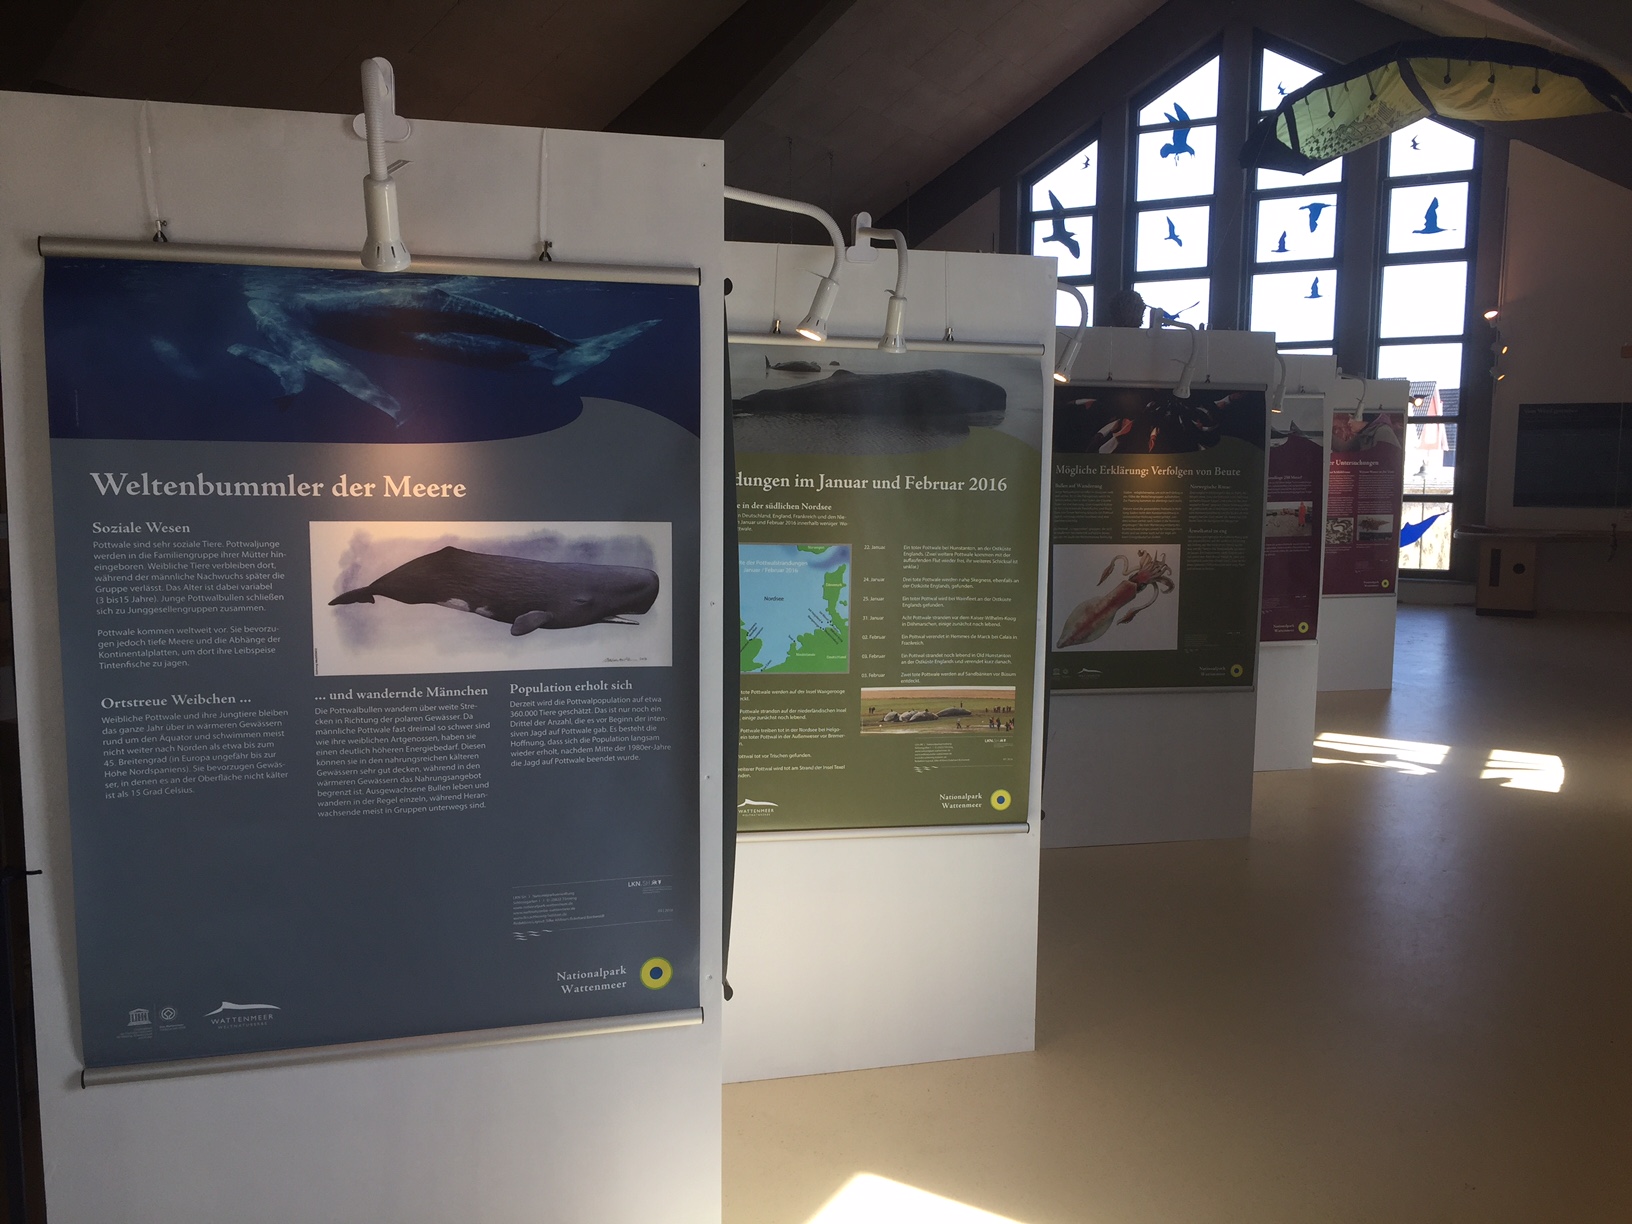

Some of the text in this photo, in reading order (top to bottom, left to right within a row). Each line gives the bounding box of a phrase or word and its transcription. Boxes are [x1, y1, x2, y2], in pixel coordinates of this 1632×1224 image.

[1055, 465, 1098, 477] Mögliche
[1099, 465, 1149, 477] Erklärung:
[1150, 466, 1194, 478] Verfolgen
[1213, 466, 1241, 476] Beute
[91, 472, 466, 498] Weltenbummler der Meere
[735, 472, 1008, 493] dungen im Januar und Februar 2016
[741, 501, 832, 510] in der südlichen Nordsee
[92, 522, 191, 533] Soziale Wesen
[93, 539, 280, 550] Pottwale sind sehr soziale Tiere. Pottwaljunge
[93, 550, 287, 561] werden in die Familiengruppe ihrer Mütter hin-
[147, 561, 188, 570] Weibliche
[189, 561, 210, 570] Tiere
[211, 561, 255, 569] verbleiben
[159, 594, 186, 604] Junge
[187, 593, 244, 602] Pottwalbullen
[245, 592, 284, 601] schließen
[328, 688, 354, 700] und
[355, 687, 423, 699] wandernde
[424, 685, 488, 697] Männchen
[509, 679, 633, 696] Population erholt sich
[100, 696, 168, 709] Ortstreue
[170, 693, 237, 706] Weibchen
[510, 694, 662, 708] Derzeit wird die Pottwalpopulation auf etwa
[314, 701, 478, 715] Die Pottwalbullen wandern über weite Stre-
[510, 708, 538, 718] 360.000
[538, 708, 556, 716] Tiere
[593, 706, 607, 714] Das
[608, 705, 617, 714] ist
[631, 704, 649, 713] noch
[650, 704, 662, 712] ein
[101, 707, 288, 724] Weibliche Pottwale und ihre Jungtiere bleiben
[105, 786, 194, 799] ist als 15 Grad Celsius.
[557, 966, 626, 981] Nationalpark
[561, 982, 626, 994] Wattenmeer
[211, 1014, 273, 1025] WATTENMEER
